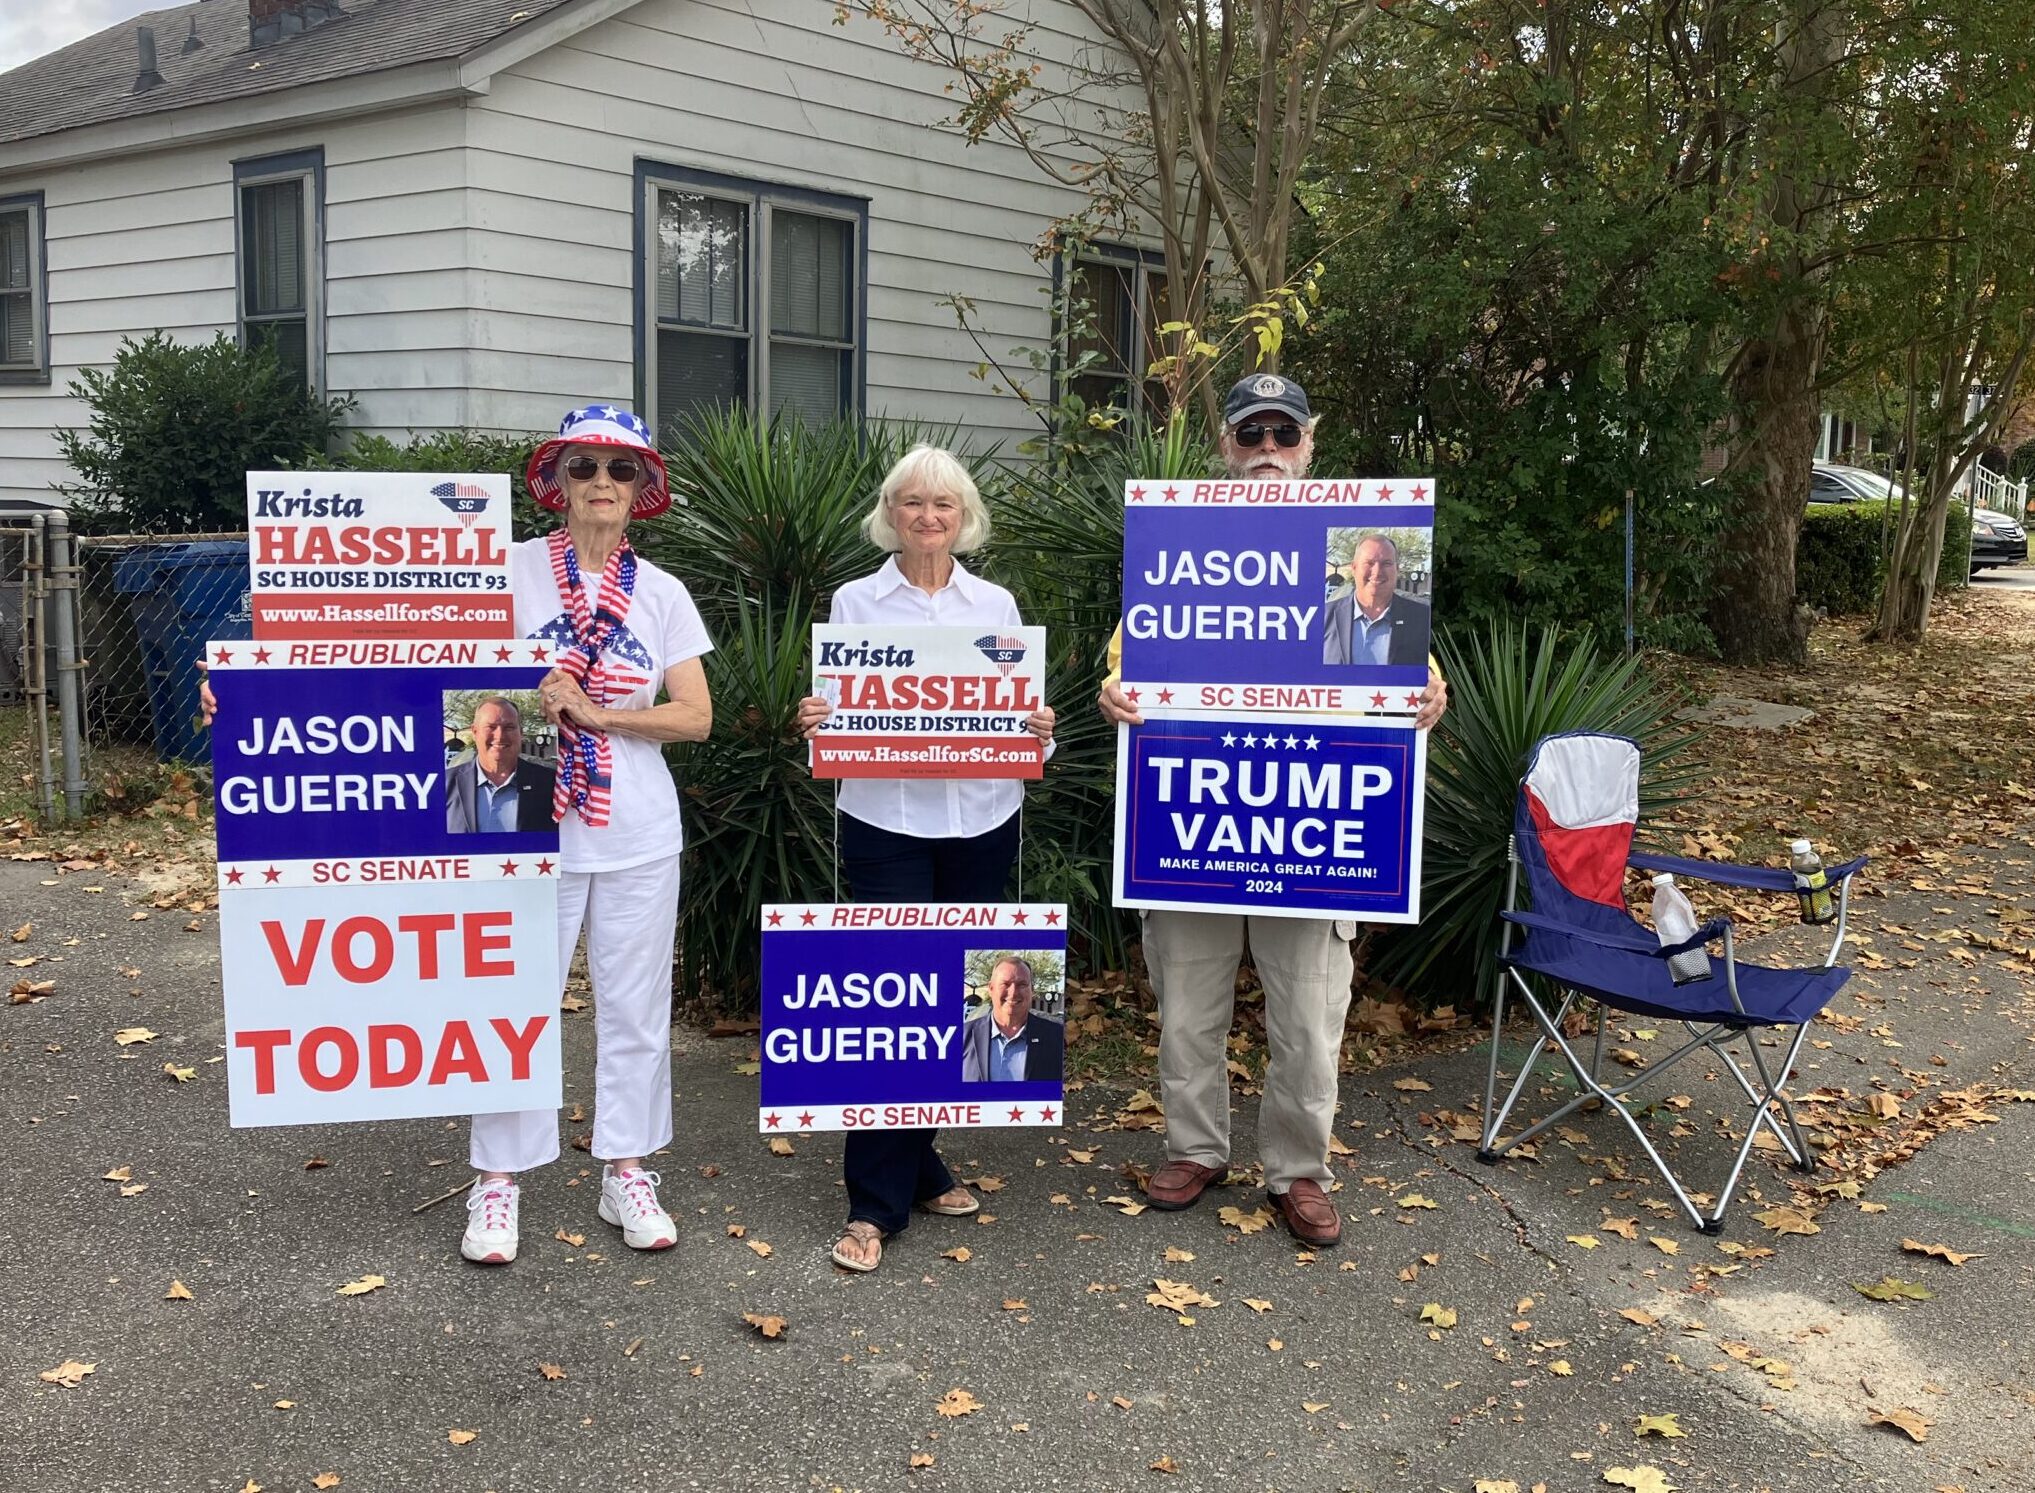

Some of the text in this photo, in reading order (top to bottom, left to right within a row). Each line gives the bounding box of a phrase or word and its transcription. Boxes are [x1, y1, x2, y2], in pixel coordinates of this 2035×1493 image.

[255, 488, 364, 518] Krista
[457, 499, 475, 511] SC
[1193, 484, 1361, 503] REPUBLICAN
[255, 526, 506, 566] HASSELL
[257, 571, 507, 590] SC HOUSE DISTRICT 93
[1144, 550, 1299, 587] JASON
[260, 604, 508, 623] www.HassellforSC.com
[1126, 605, 1318, 640] GUERRY
[288, 643, 477, 666] REPUBLICAN
[818, 640, 915, 667] Krista
[997, 650, 1013, 661] SC
[1200, 687, 1342, 708] SC SENATE
[847, 716, 918, 731] HOUSE
[921, 716, 1016, 731] DISTRICT
[237, 715, 415, 757] JASON
[820, 746, 1037, 763] www.HassellforSC.com
[220, 773, 438, 814] GUERRY
[1148, 757, 1393, 811] TRUMP
[1170, 813, 1365, 859] VANCE
[312, 859, 470, 883] SC SENATE
[1159, 858, 1377, 878] MAKE AMERICA GREAT AGAIN!
[1246, 880, 1284, 893] 2024
[831, 907, 997, 927] REPUBLICAN
[260, 911, 515, 986] VOTE
[783, 973, 938, 1009] JASON
[235, 1016, 550, 1095] TODAY
[765, 1026, 957, 1064] GUERRY
[842, 1105, 981, 1127] SC SENATE
